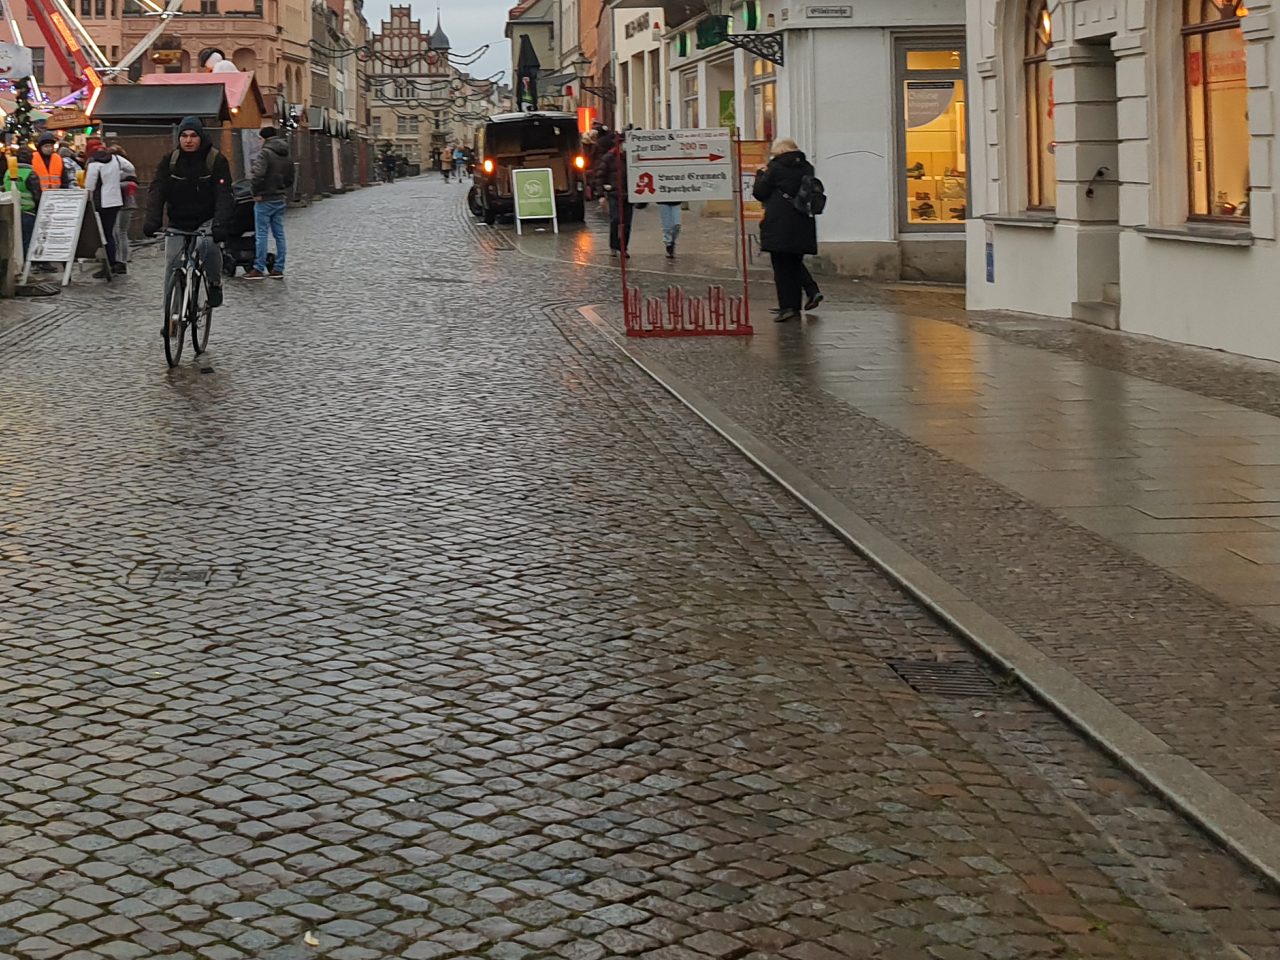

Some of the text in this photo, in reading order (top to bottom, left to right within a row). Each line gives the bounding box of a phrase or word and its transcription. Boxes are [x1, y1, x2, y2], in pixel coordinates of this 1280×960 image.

[631, 133, 666, 142] Pension
[680, 143, 697, 151] 200
[658, 184, 702, 193] Apotheke
